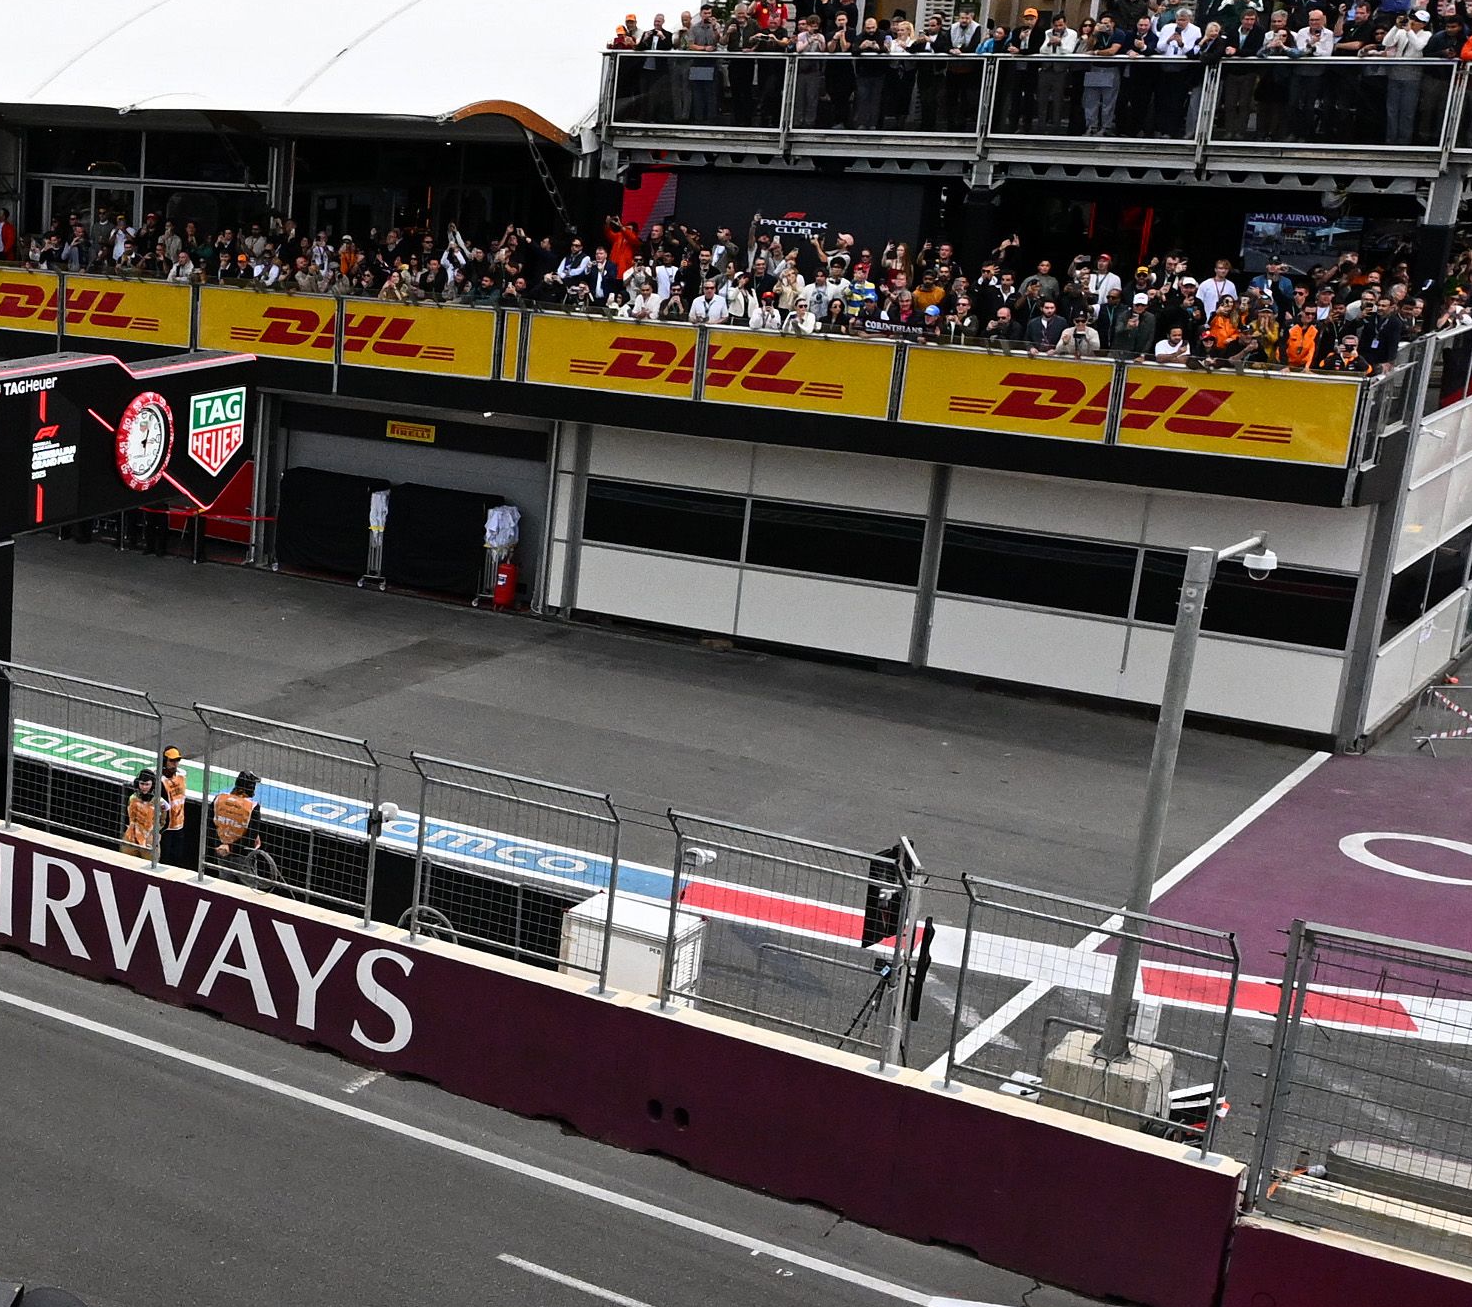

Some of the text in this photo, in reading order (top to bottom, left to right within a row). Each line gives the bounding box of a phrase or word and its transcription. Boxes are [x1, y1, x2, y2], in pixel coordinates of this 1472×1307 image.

[760, 218, 828, 229] PADDOCK
[775, 227, 812, 235] CLUB
[1286, 214, 1327, 223] AIRWAYS
[259, 307, 423, 358] DHL
[865, 320, 923, 334] CORINTHIANS
[604, 338, 807, 394] DHL
[195, 394, 242, 422] TAG
[991, 373, 1246, 439] DHL
[192, 426, 242, 473] HEUER
[300, 800, 589, 872] aramco
